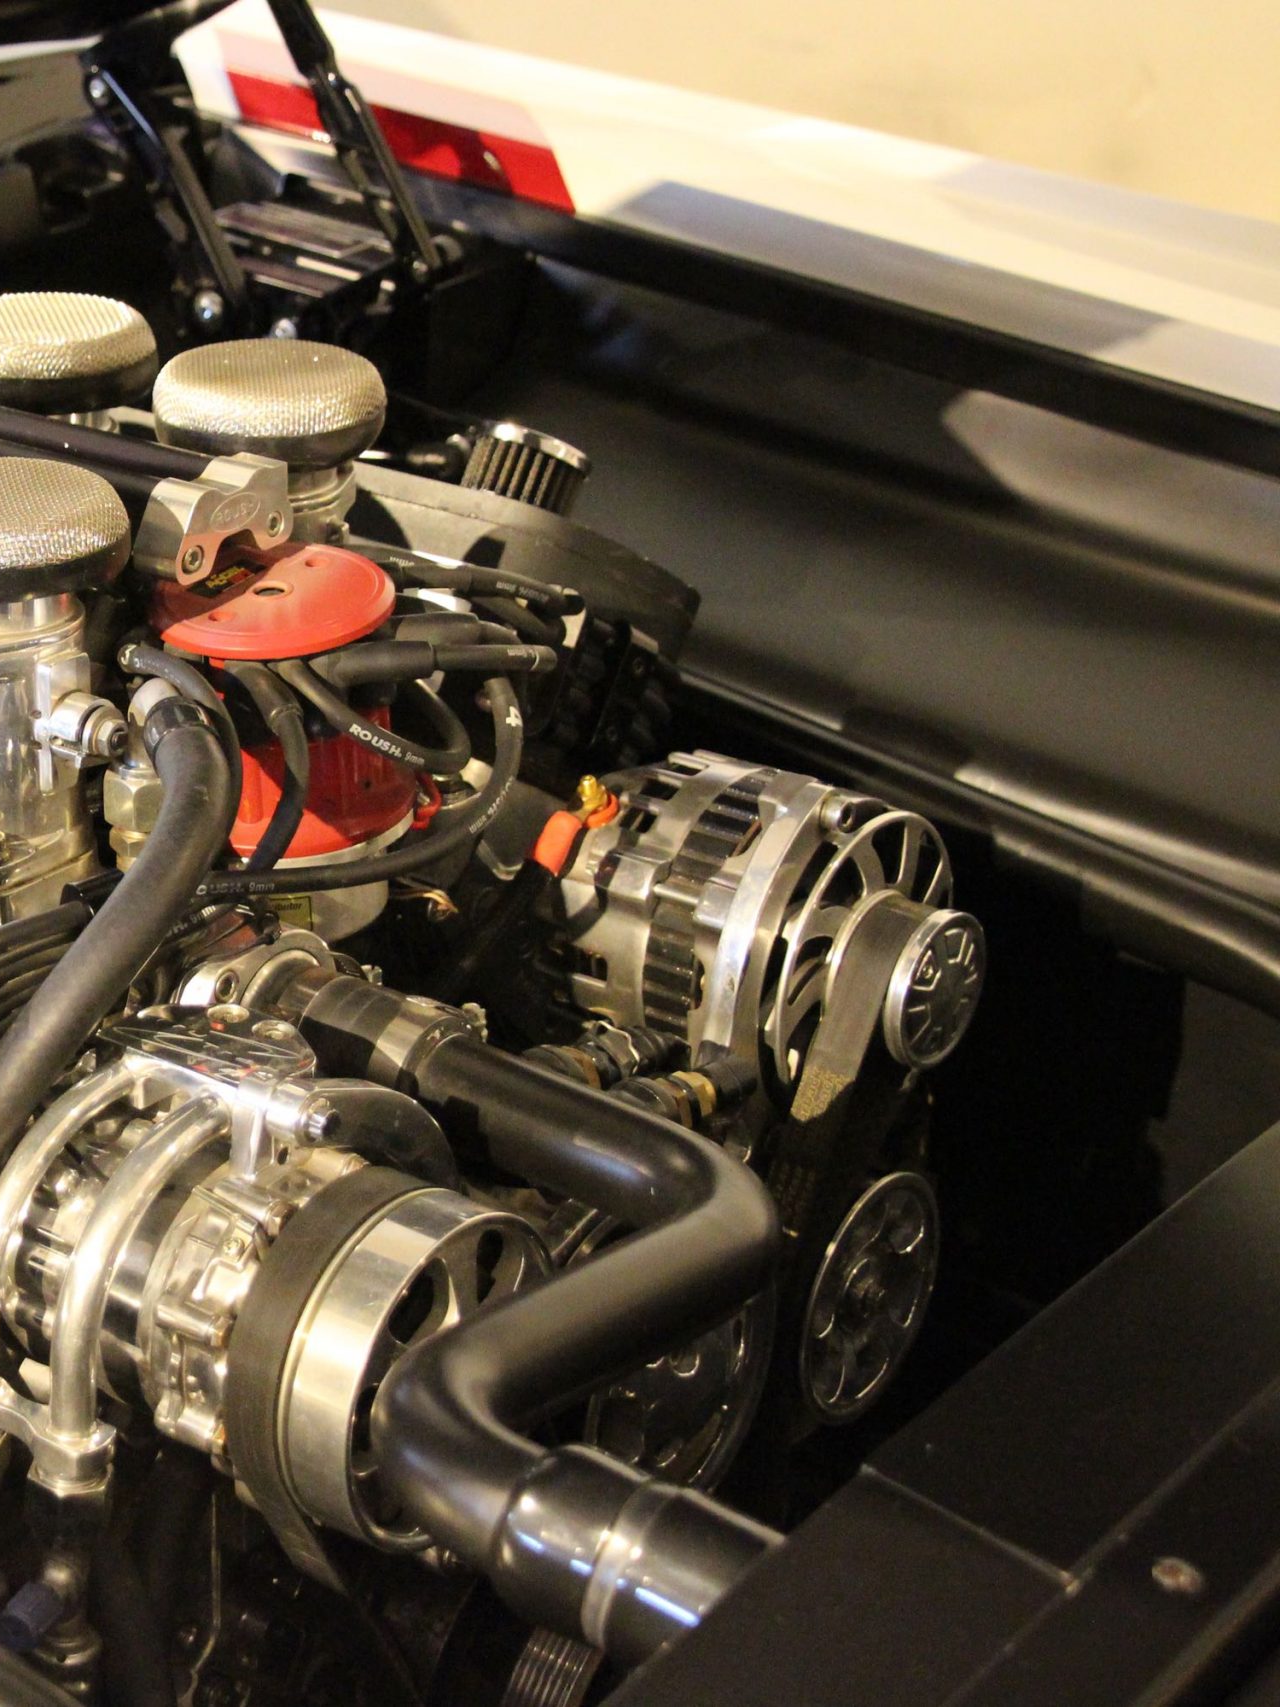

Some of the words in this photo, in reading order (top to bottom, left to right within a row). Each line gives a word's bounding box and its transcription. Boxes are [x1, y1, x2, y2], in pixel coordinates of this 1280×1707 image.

[505, 705, 523, 728] 4
[349, 723, 399, 757] ROUSH
[405, 752, 425, 766] 9mm
[248, 881, 275, 892] 9mm
